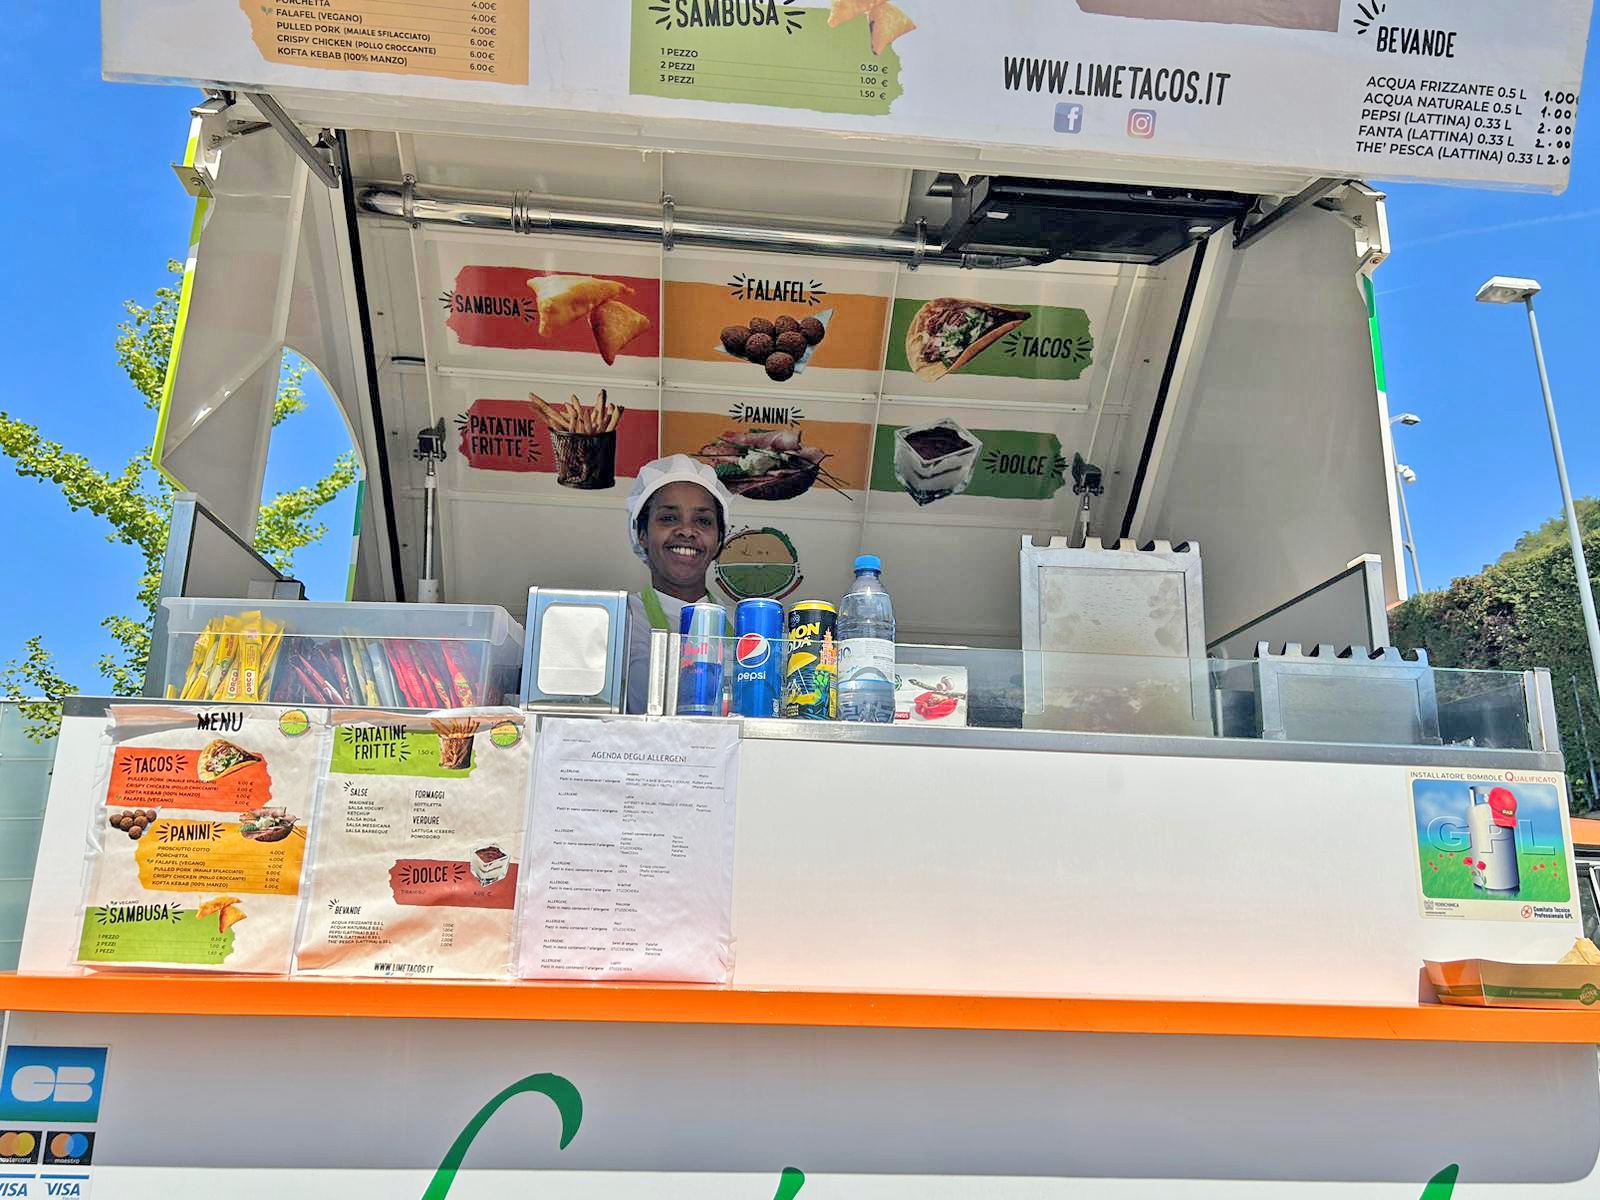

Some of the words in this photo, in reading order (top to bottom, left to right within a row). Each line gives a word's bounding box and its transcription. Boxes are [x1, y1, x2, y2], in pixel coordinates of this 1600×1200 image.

[471, 2, 497, 11] 4.00€
[676, 0, 779, 28] SAMBUSA
[276, 9, 316, 19] FALAFEL
[318, 12, 362, 24] (VEGANO)
[471, 26, 497, 36] 4.00€
[471, 14, 497, 23] 4.00€
[277, 22, 312, 31] PULLED
[314, 25, 341, 34] PORK
[344, 27, 376, 37] (MAIALE
[377, 30, 431, 42] SFILACCIATO)
[470, 38, 495, 48] 6.00€
[1376, 26, 1457, 58] BEVANDE
[277, 34, 310, 44] CRISPY
[312, 38, 352, 48] CHICKEN
[355, 41, 383, 51] (POLLO
[384, 44, 436, 55] CROCCANTE)
[470, 50, 495, 60] 6.00€
[277, 47, 308, 57] KOFTA
[310, 50, 342, 60] KEBAB
[344, 52, 369, 62] (100%
[370, 55, 408, 67] MANZO)
[470, 63, 495, 73] 6.00€
[661, 48, 665, 57] 1
[667, 49, 699, 59] PEZZO
[860, 64, 879, 73] 0.50
[881, 66, 888, 75] €
[660, 61, 666, 70] 2
[668, 62, 695, 72] PEZZI
[860, 77, 876, 86] 1.00
[881, 79, 888, 88] €
[1004, 56, 1231, 106] WWW.LIMETACOS.IT
[660, 75, 666, 84] 3
[668, 75, 695, 85] PEZZI
[859, 90, 875, 99] 1.50
[879, 92, 886, 101] €
[1366, 76, 1417, 91] ACQUA
[1420, 80, 1495, 97] FRIZZANTE
[1498, 87, 1517, 99] 0.5
[1520, 89, 1527, 100] L
[1363, 92, 1413, 107] ACQUA
[1418, 96, 1489, 113] NATURALE
[1493, 103, 1512, 114] 0.5
[1516, 105, 1522, 116] L
[1361, 109, 1400, 122] PEPSI
[1404, 112, 1472, 129] (LATTINA)
[1474, 118, 1501, 130] 0.33
[1505, 120, 1512, 130] L
[1358, 126, 1403, 139] FANTA
[1407, 128, 1474, 146] (LATTINA)
[1477, 134, 1504, 146] 0.33
[1508, 136, 1514, 147] L
[1390, 144, 1434, 156] PESCA
[1438, 146, 1503, 164] (LATTINA)
[1507, 152, 1533, 164] 0.33
[1537, 154, 1544, 165] L
[746, 279, 806, 304] FALAFEL
[455, 294, 521, 317] SAMBUSA
[1022, 337, 1073, 358] TACOS
[744, 406, 789, 424] PANINI
[470, 415, 535, 437] PATATINE
[471, 437, 522, 458] FRITTE
[999, 454, 1048, 476] DOLCE
[737, 670, 766, 682] pepsi
[196, 712, 244, 732] MENU
[355, 724, 408, 743] PATATINE
[355, 742, 396, 760] FRITTE
[591, 752, 622, 760] AGENDA
[624, 752, 645, 760] DEGLI
[648, 754, 686, 763] ALLERGENI
[134, 756, 174, 773] TACOS
[1410, 772, 1464, 780] INSTALLATORE
[1466, 774, 1502, 782] BOMBOLE
[350, 788, 368, 797] SALSE
[414, 790, 445, 800] FORMAGGI
[412, 816, 440, 825] VERDURE
[170, 824, 210, 842] PANINI
[412, 866, 448, 885] DOLCE
[110, 904, 168, 924] SAMBUSA
[334, 906, 362, 915] BEVANDE
[11, 1065, 96, 1103] CB
[45, 1183, 80, 1196] VISA
